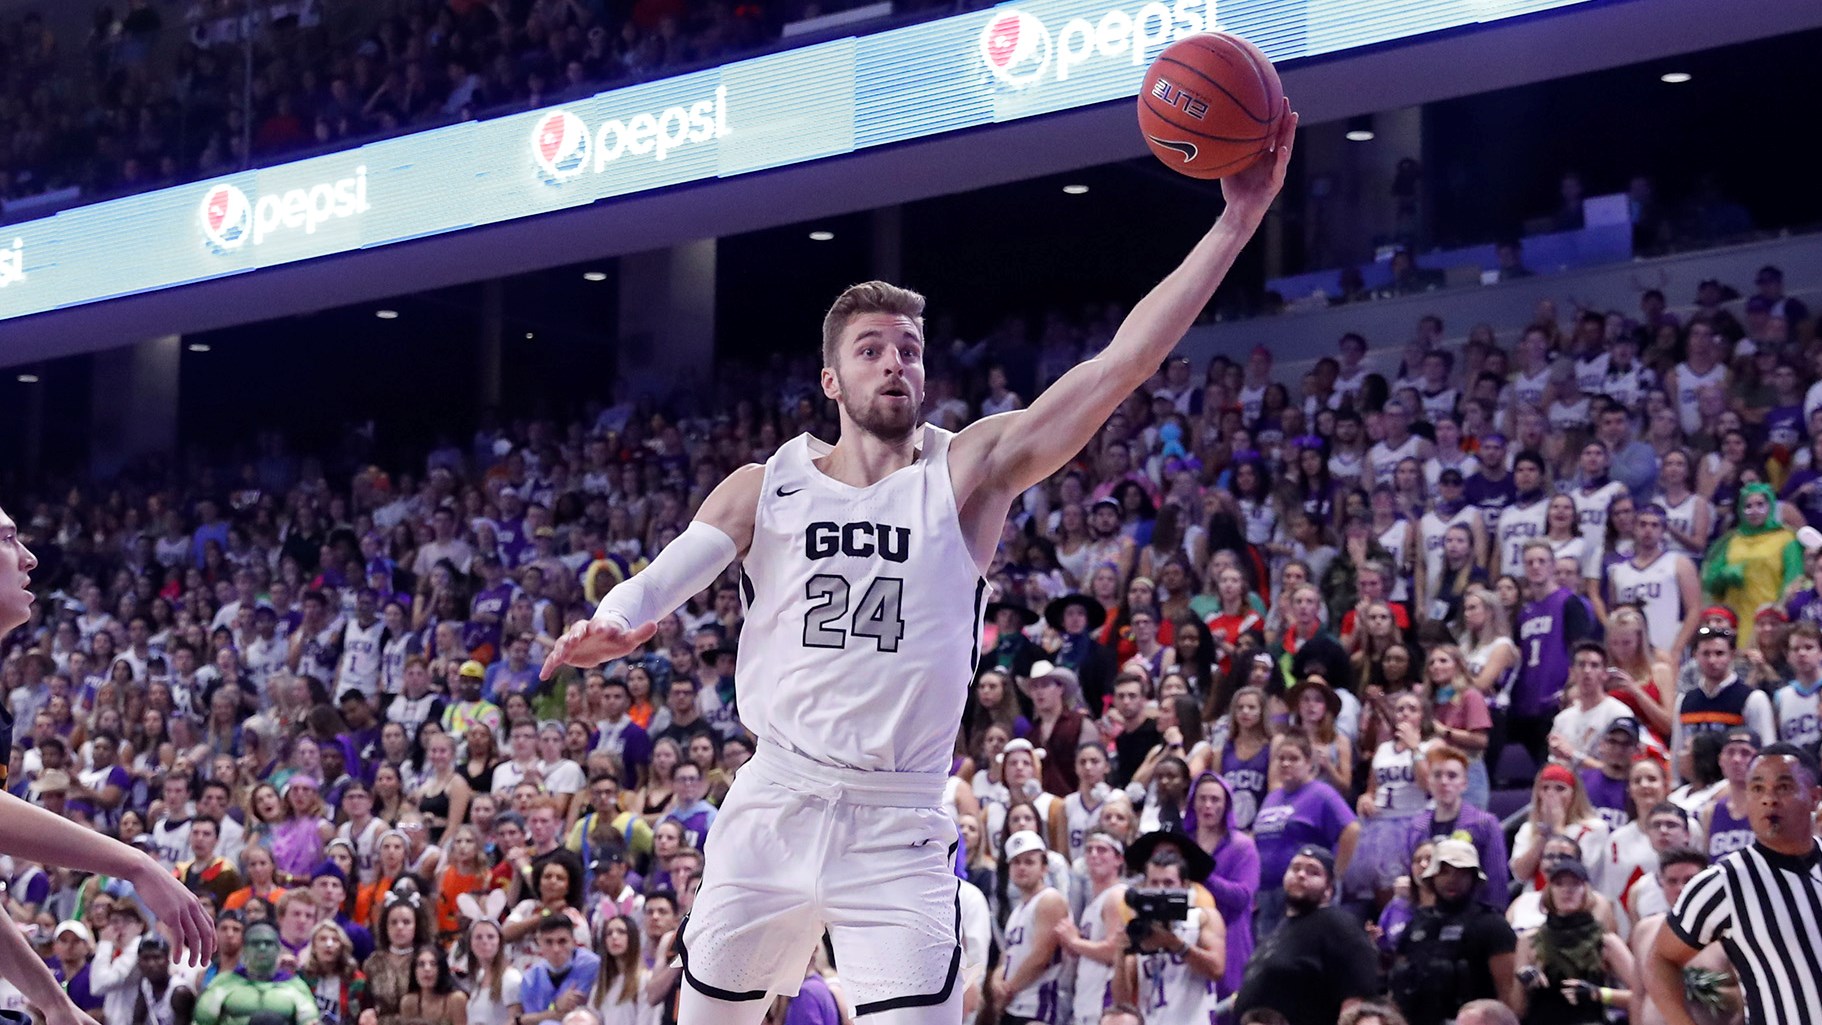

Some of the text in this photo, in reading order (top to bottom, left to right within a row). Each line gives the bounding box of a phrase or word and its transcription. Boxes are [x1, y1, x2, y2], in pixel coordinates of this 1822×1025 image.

[1056, 0, 1222, 81] pepsi
[594, 84, 732, 174] pepsi
[253, 165, 370, 245] pepsi
[805, 521, 911, 564] GCU
[803, 574, 905, 653] 24
[1528, 639, 1541, 667] 1
[1223, 769, 1265, 792] GCU
[1710, 829, 1756, 857] GCU
